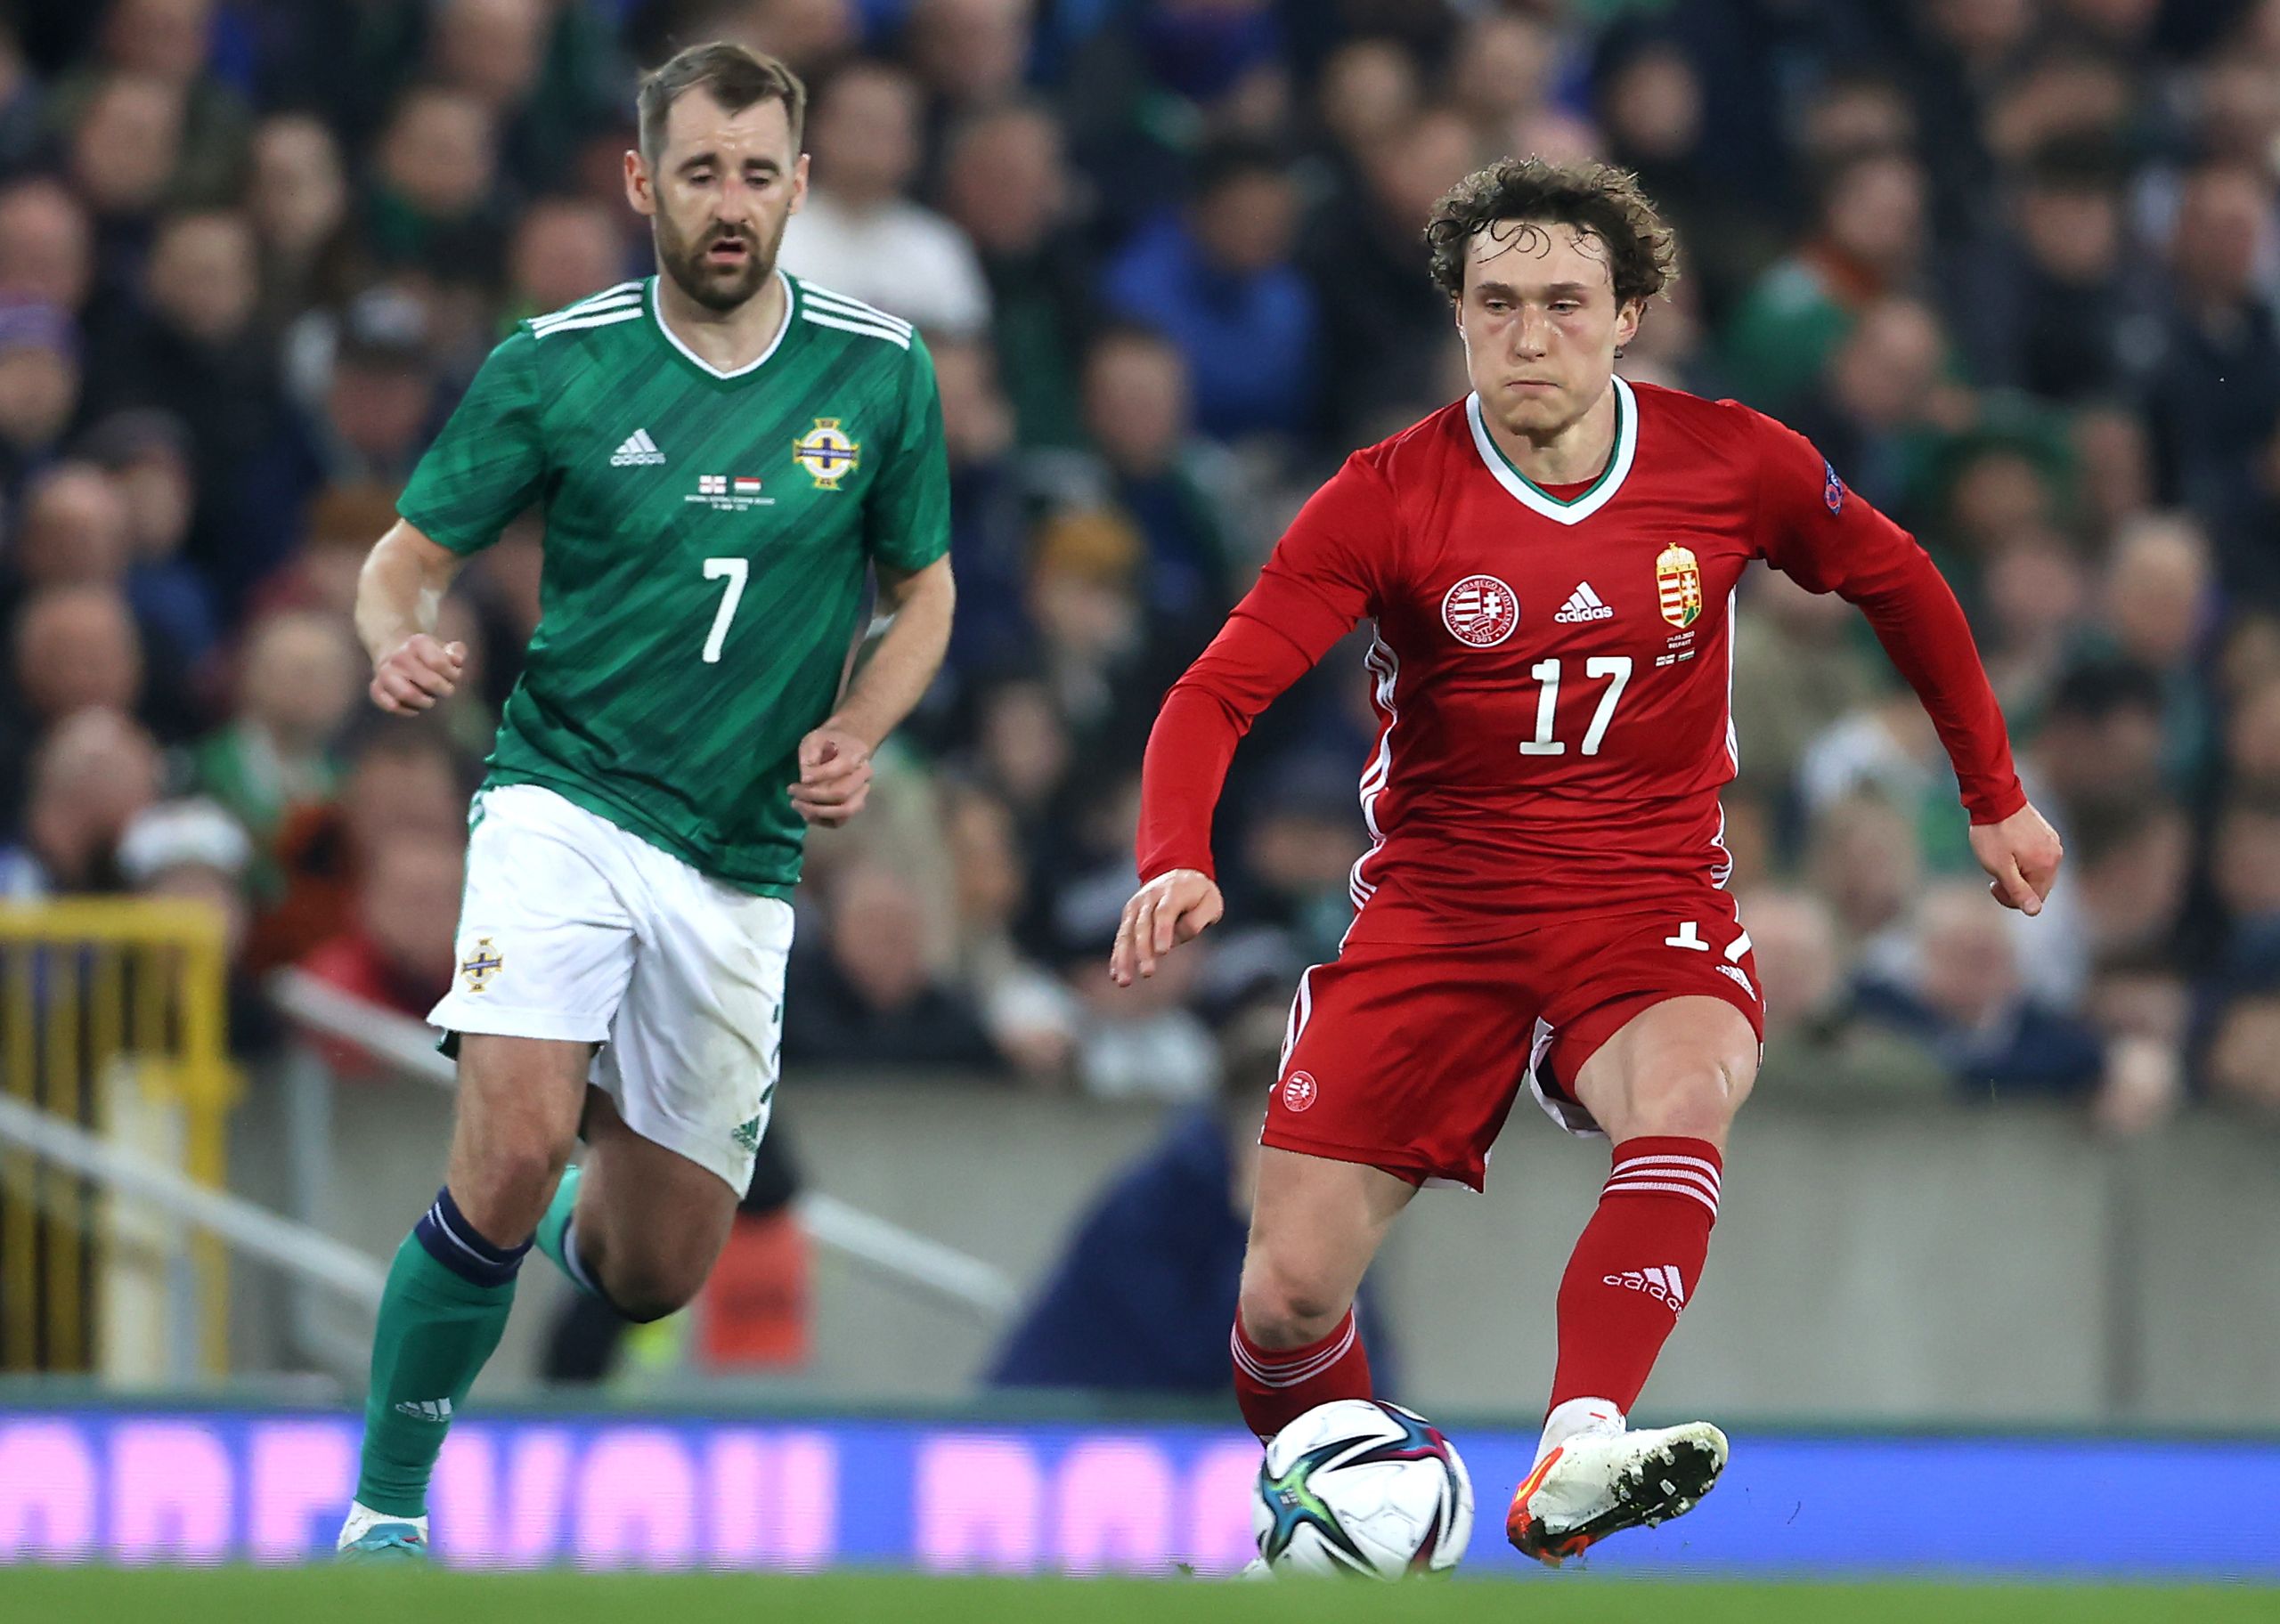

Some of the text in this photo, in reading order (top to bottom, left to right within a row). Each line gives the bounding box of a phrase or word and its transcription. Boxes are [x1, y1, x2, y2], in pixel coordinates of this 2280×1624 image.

[702, 557, 749, 663] 7
[1447, 604, 1463, 635] MAGYAR
[1554, 605, 1614, 623] adidas
[1519, 656, 1633, 756] 17
